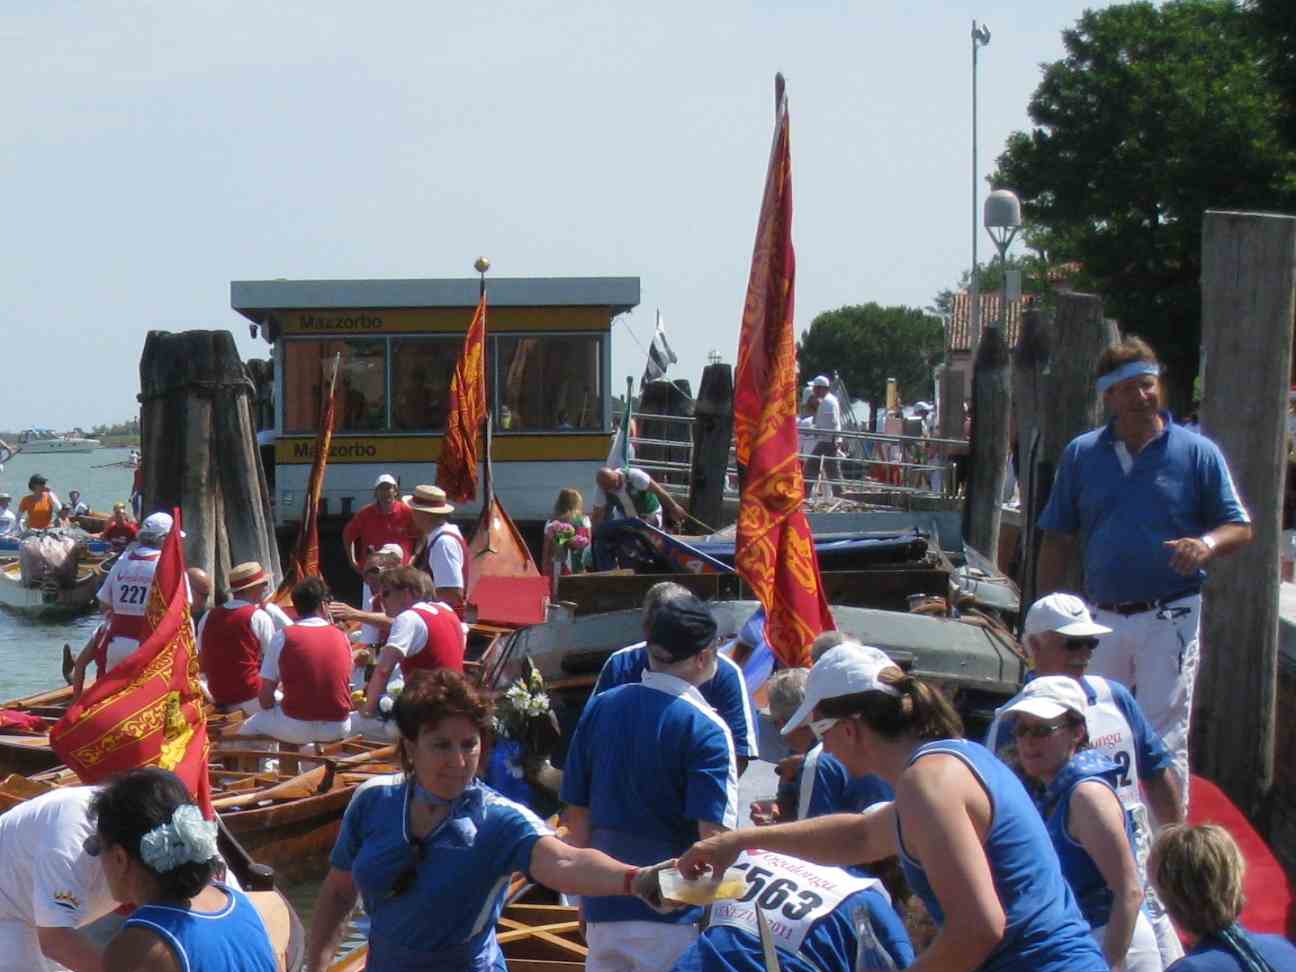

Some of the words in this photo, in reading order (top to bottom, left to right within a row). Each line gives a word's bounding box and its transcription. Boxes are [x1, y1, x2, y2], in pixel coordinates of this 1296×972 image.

[299, 313, 384, 329] Mazzorbo
[293, 442, 377, 458] Mazorbo
[120, 584, 147, 605] 227
